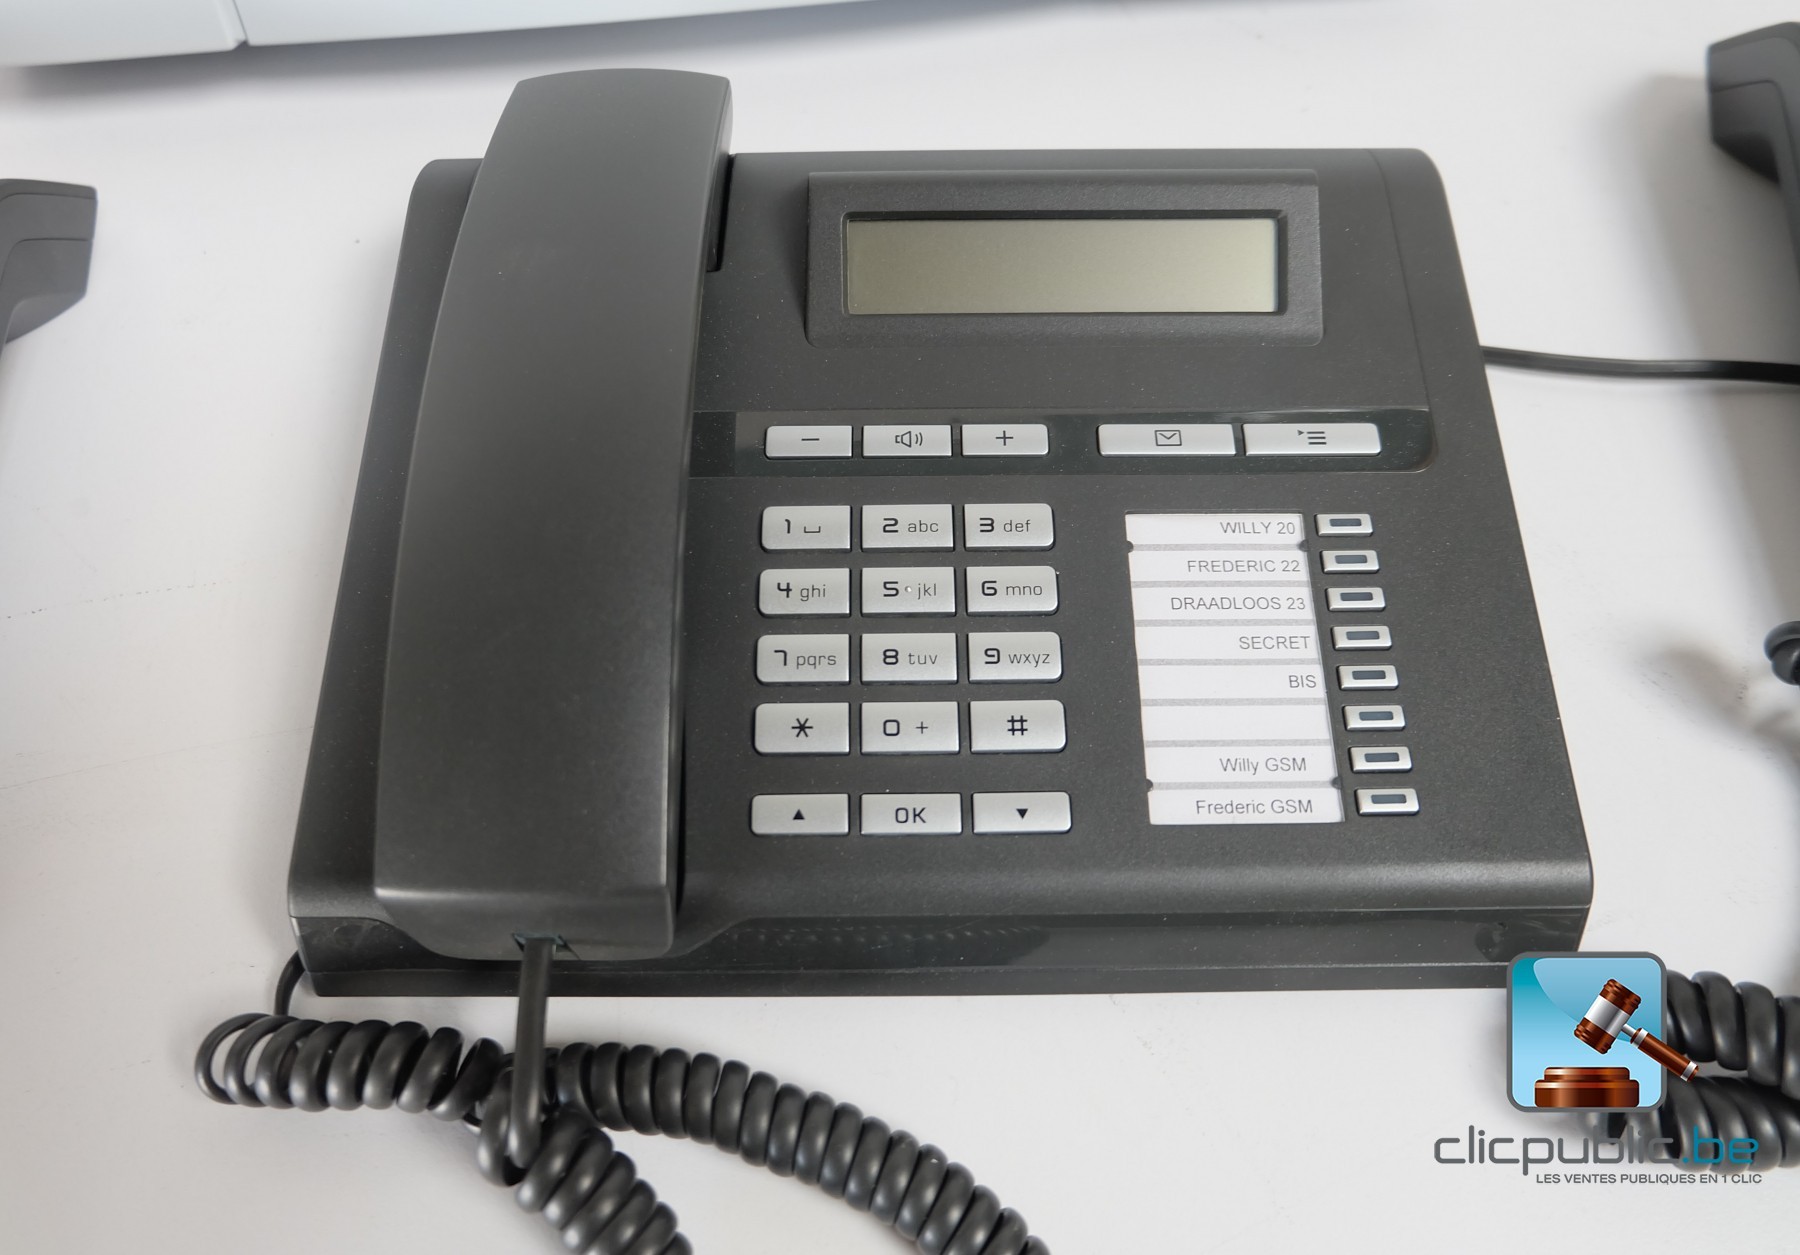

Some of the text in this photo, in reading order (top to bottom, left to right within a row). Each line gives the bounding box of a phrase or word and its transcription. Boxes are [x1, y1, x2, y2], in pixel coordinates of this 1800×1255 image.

[784, 518, 792, 534] 1
[882, 517, 940, 534] 2 abc
[978, 517, 1031, 533] 3 def
[1220, 521, 1296, 535] WILLY 20
[1187, 559, 1301, 573] FREDERIC 22
[777, 581, 827, 602] 4 ghi
[883, 580, 938, 600] 5 jkl
[981, 580, 1043, 597] 6 mno
[1170, 596, 1307, 611] DRAADLOOS 23
[1238, 635, 1311, 650] SECRET
[773, 649, 838, 670] 7 pqrs
[882, 648, 939, 665] 8 tuv
[984, 647, 1051, 668] 9 wxyz
[1288, 674, 1318, 689] BIS
[1219, 757, 1307, 776] Willy GSM
[895, 806, 928, 824] OK
[1195, 799, 1314, 815] Frederic GSM
